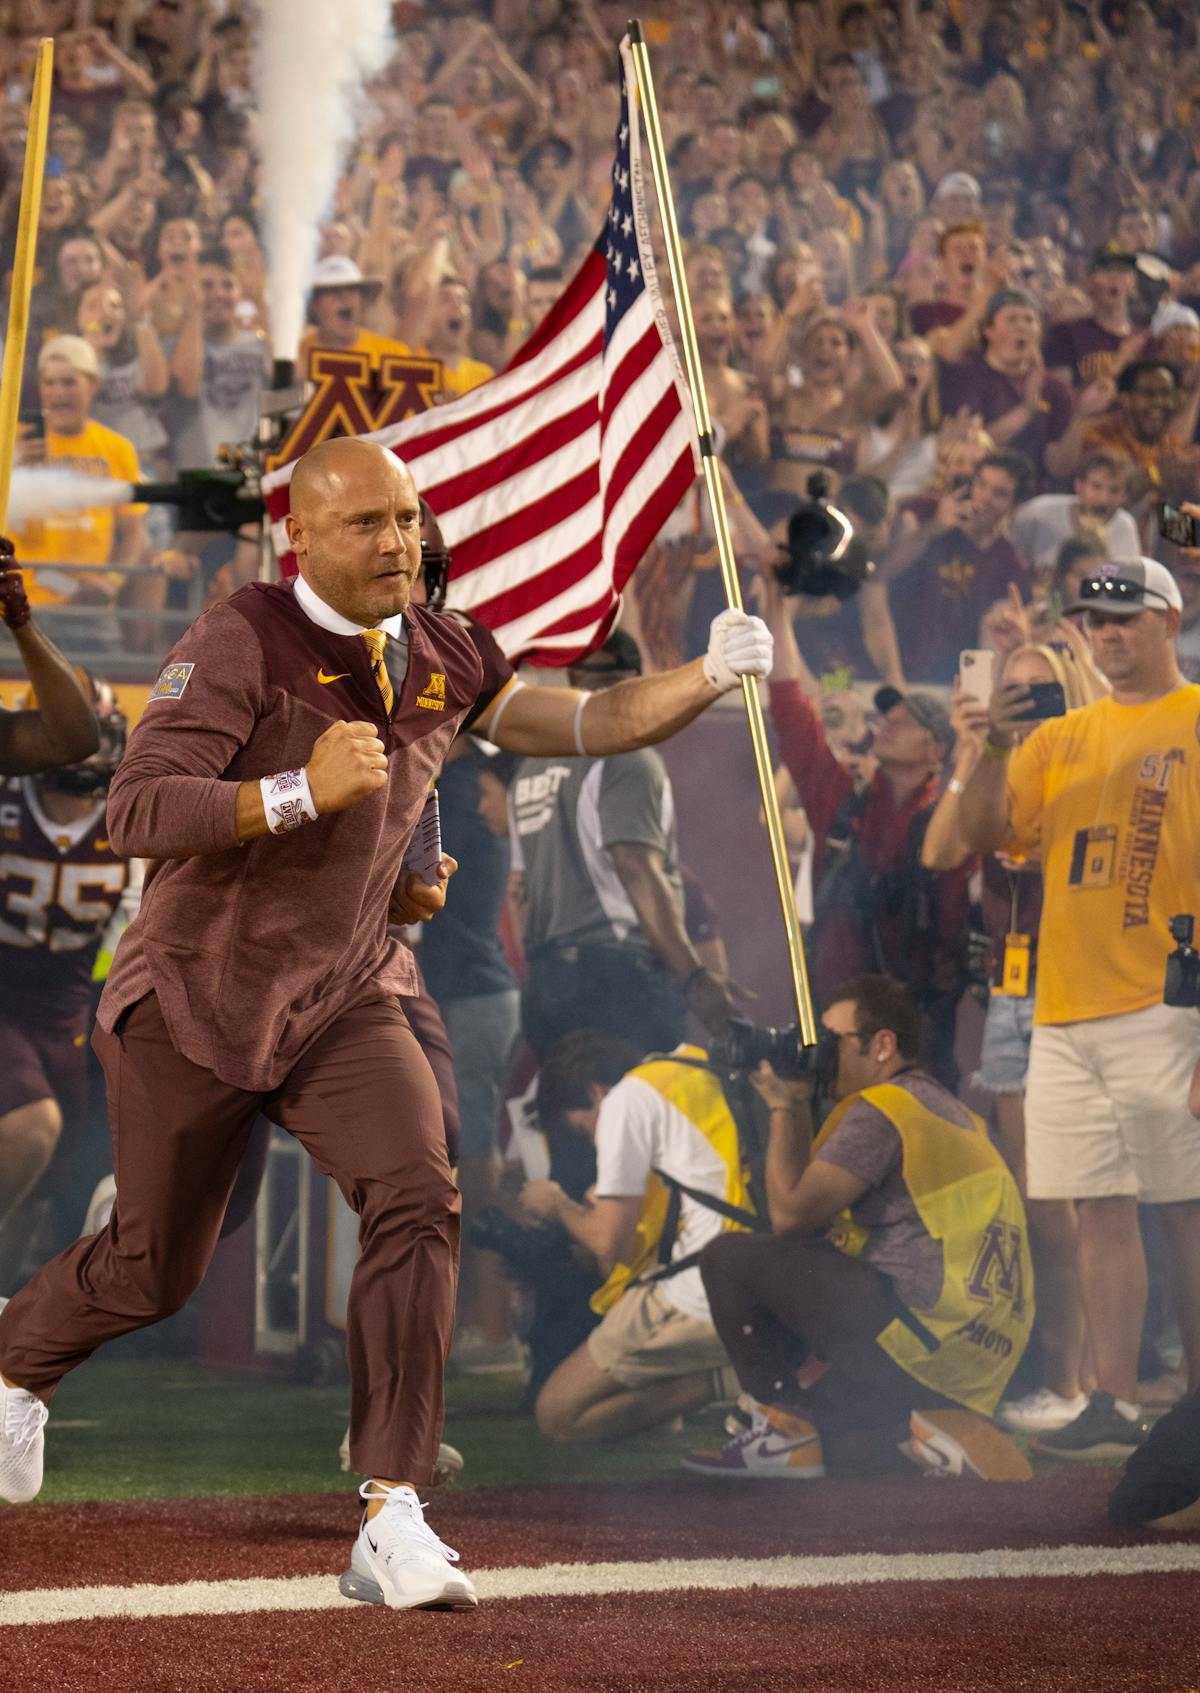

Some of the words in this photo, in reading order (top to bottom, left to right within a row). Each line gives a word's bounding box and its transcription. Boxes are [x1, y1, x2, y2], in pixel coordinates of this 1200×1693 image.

[423, 672, 446, 699] M
[282, 804, 296, 825] BOAT
[1123, 787, 1169, 930] MINNESOTA
